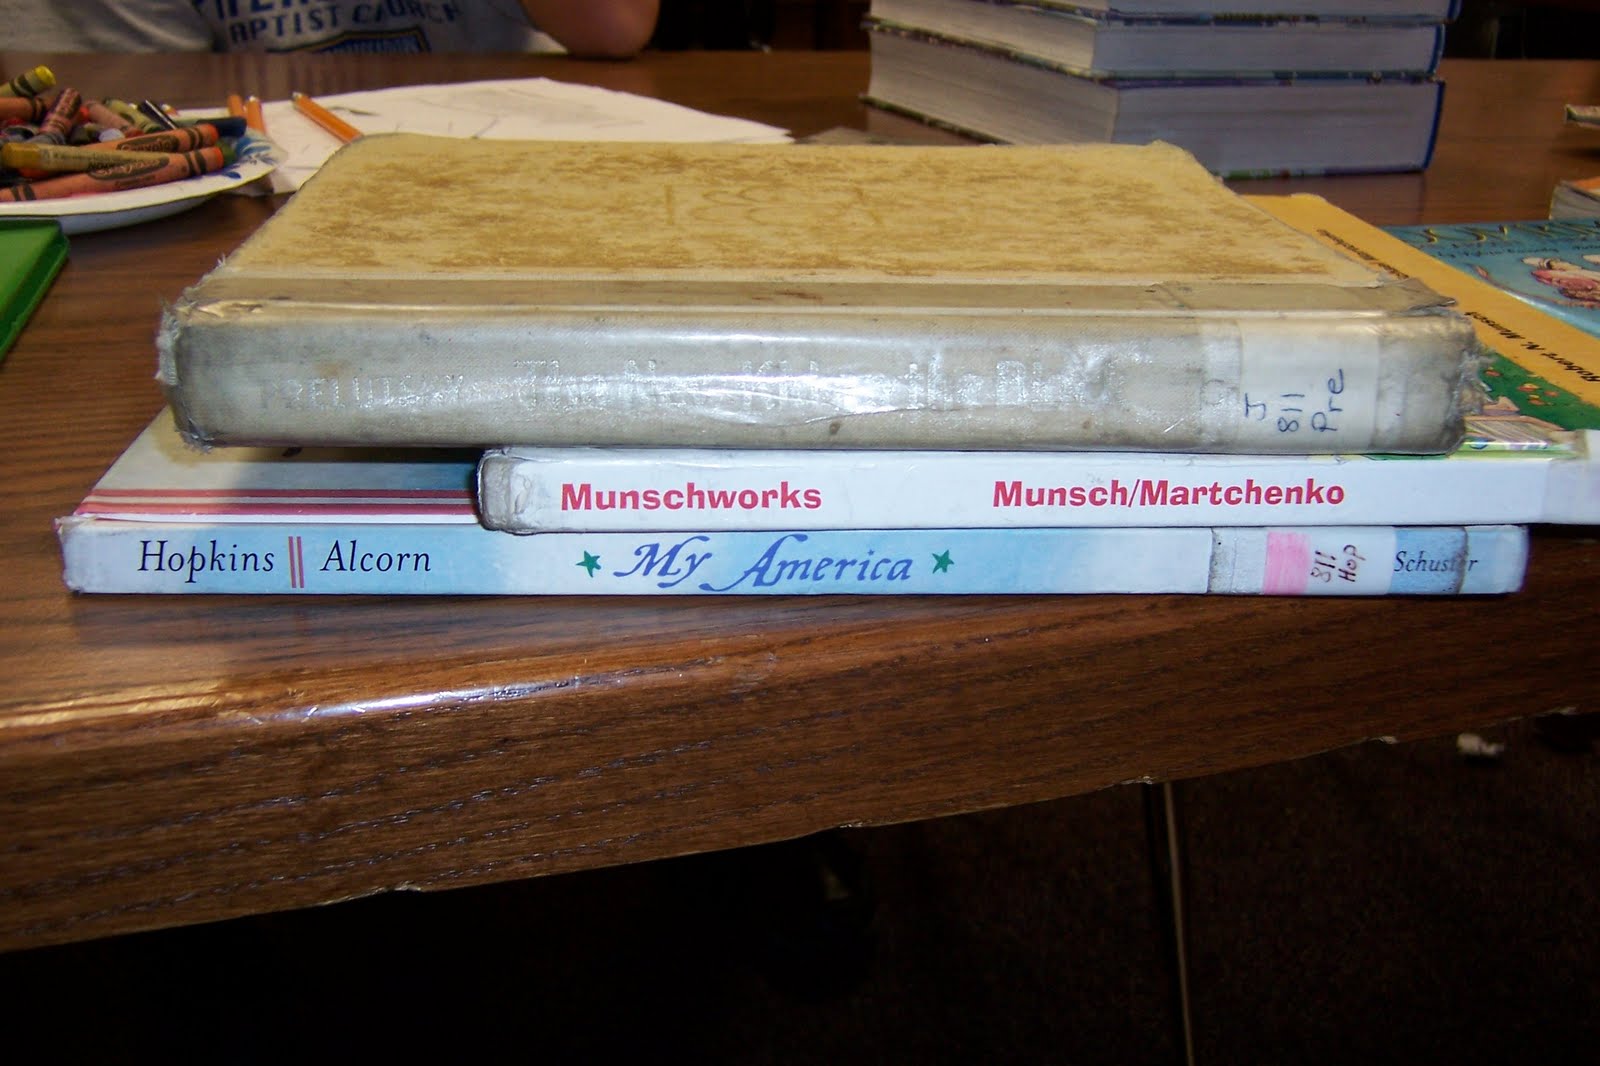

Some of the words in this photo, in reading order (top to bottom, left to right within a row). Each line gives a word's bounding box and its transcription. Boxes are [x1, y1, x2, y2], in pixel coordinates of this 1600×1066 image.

[228, 6, 342, 44] APTIST
[1277, 393, 1305, 432] 811
[1311, 368, 1344, 432] Pre
[561, 482, 822, 511] Munschworks
[993, 478, 1345, 507] Munsch/Martchenko
[137, 540, 275, 584] Hopkins
[319, 540, 432, 573] Alcorn
[613, 535, 713, 588] My
[698, 533, 913, 592] America
[1394, 550, 1478, 573] Schustr
